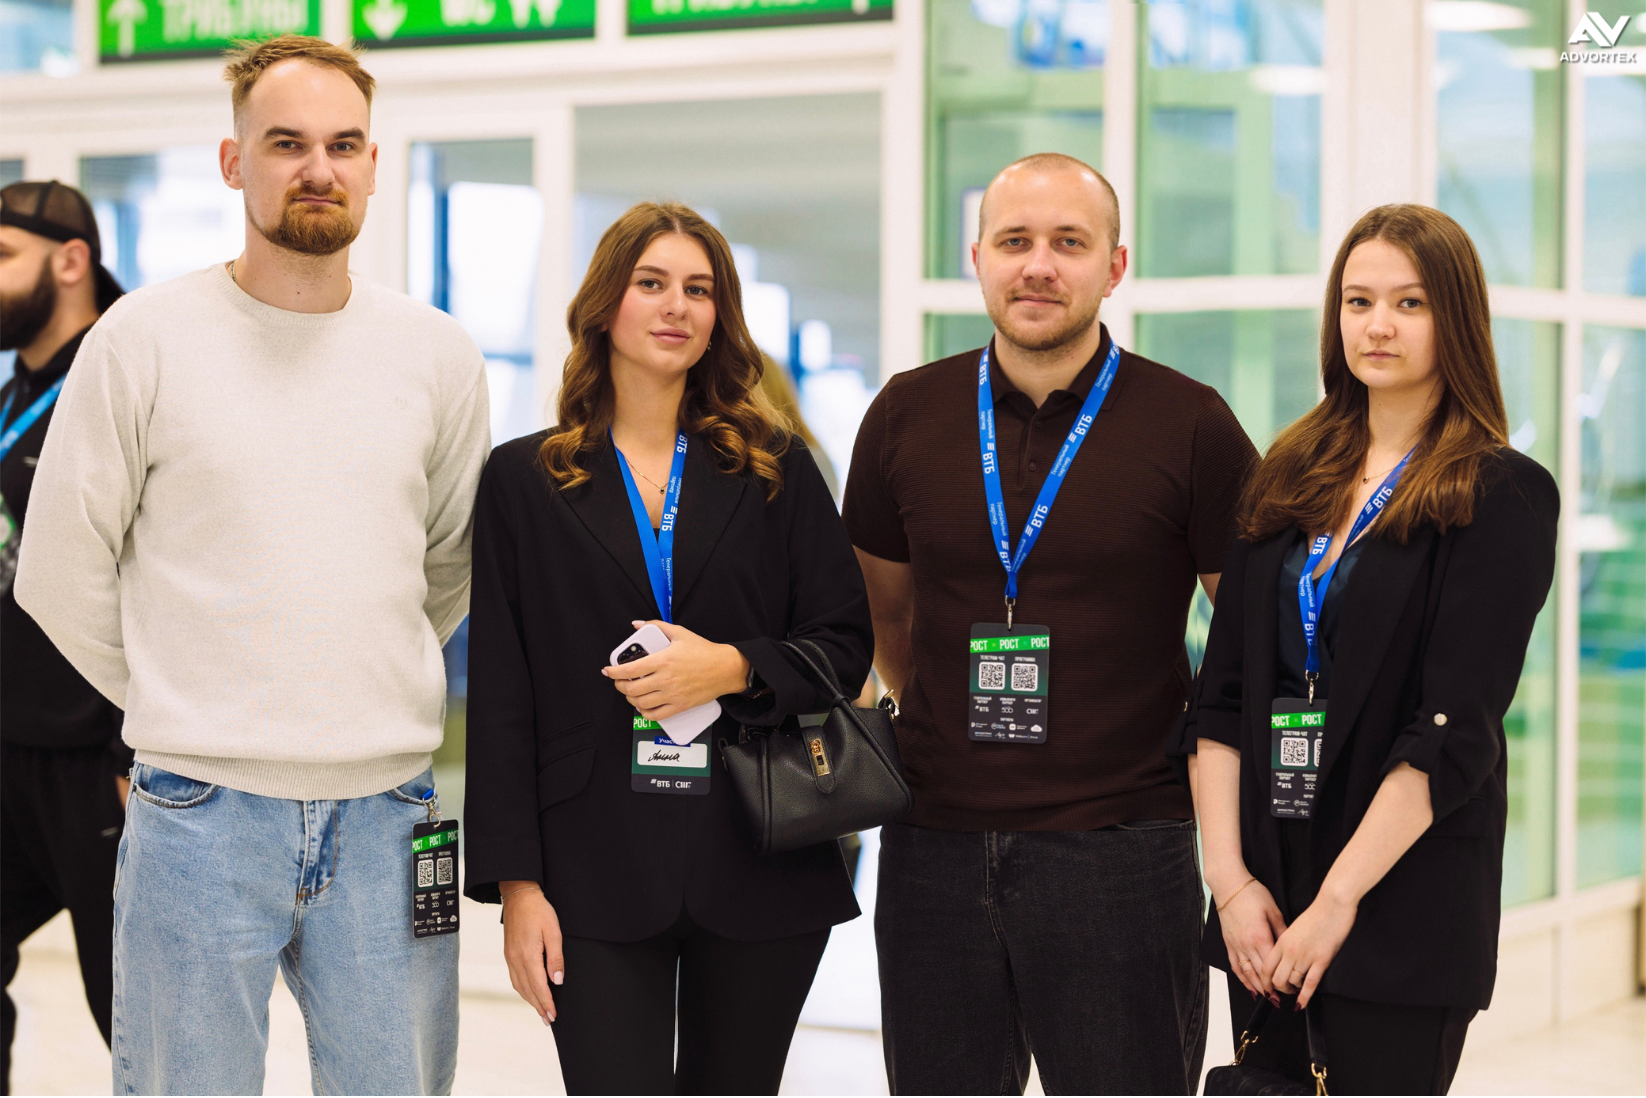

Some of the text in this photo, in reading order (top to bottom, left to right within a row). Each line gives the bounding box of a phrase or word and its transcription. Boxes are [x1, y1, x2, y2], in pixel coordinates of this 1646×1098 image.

[1074, 414, 1092, 436] ВТБ
[676, 434, 688, 454] ВТБ
[983, 452, 995, 474] ВТБ
[1372, 486, 1393, 509] ВТБ
[662, 513, 674, 531] ВТБ
[1031, 504, 1048, 528] ВТБ
[1312, 536, 1328, 555] ВТБ
[999, 638, 1019, 650] РОСТ
[1030, 636, 1049, 648] РОСТ
[1302, 714, 1322, 725] РОСТ
[656, 780, 670, 788] ВТБ
[429, 834, 441, 847] РОСТ
